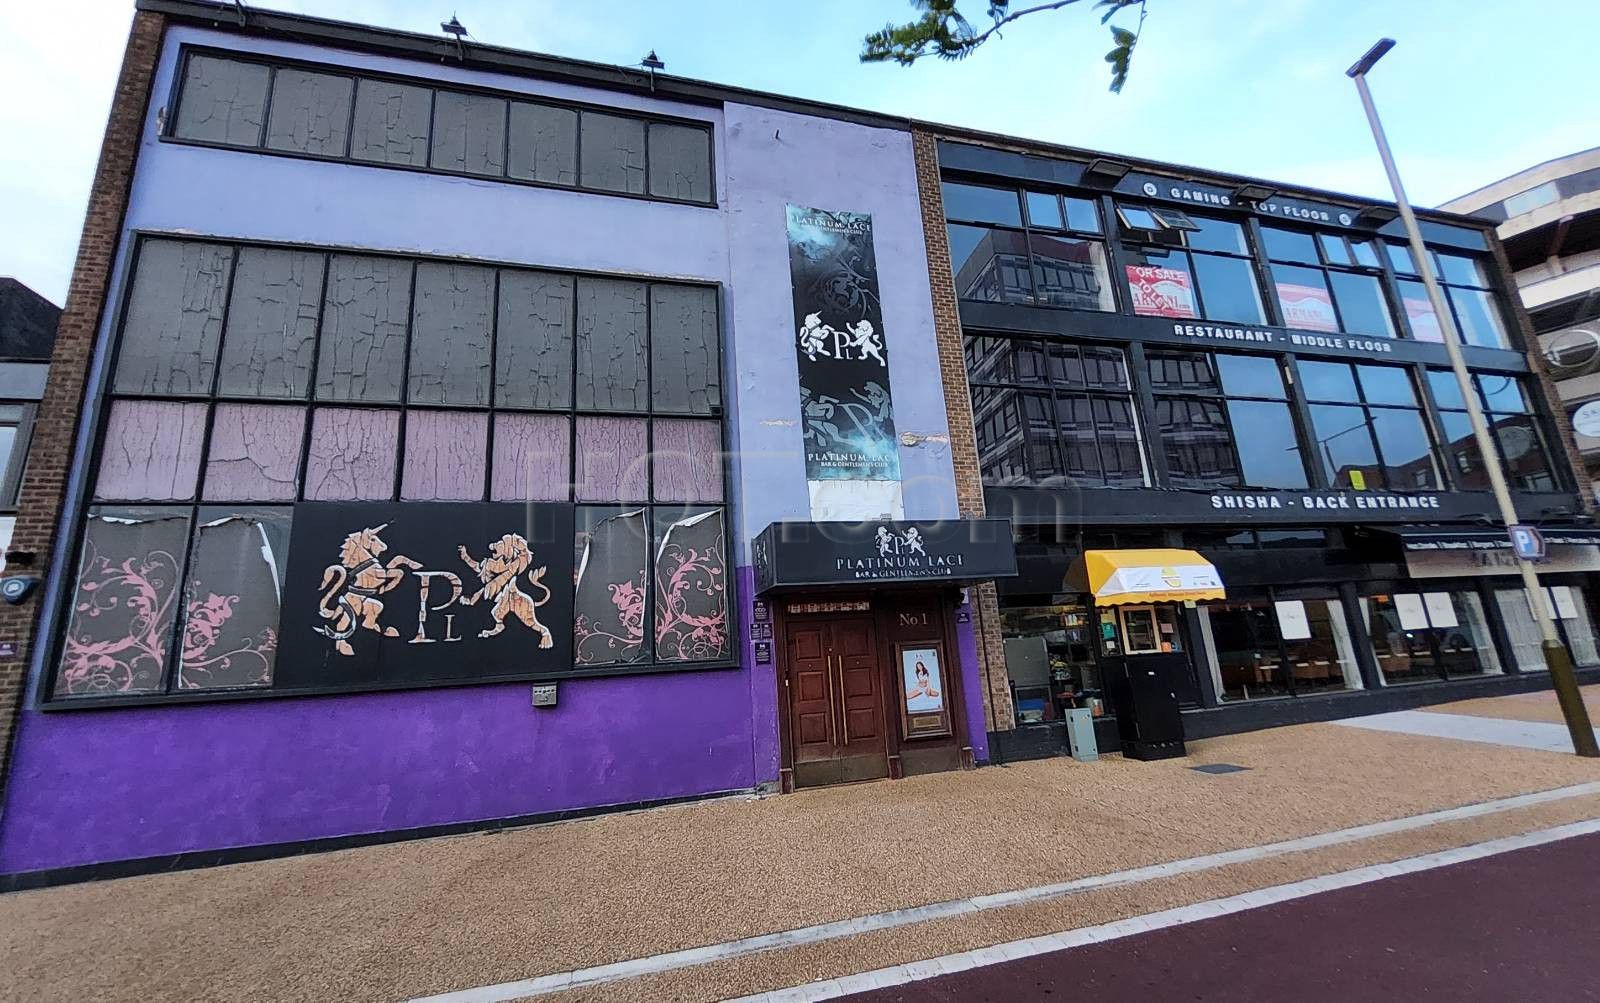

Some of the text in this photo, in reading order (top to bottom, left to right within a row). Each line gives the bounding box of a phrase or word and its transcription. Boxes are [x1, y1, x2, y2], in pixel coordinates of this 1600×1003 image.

[1171, 188, 1230, 205] GAMING
[1250, 201, 1277, 212] TOP
[1283, 206, 1329, 221] FLOOR
[1174, 325, 1272, 342] RESTAURANT
[1292, 335, 1343, 349] MIDDLE
[1349, 340, 1392, 352] FLOOR
[808, 453, 866, 461] PLATINUM
[1211, 496, 1281, 509] SHISHA
[1302, 496, 1350, 509] BACK
[1355, 497, 1439, 508] ENTRANCE
[836, 557, 920, 570] PLATINUM
[899, 613, 918, 626] No
